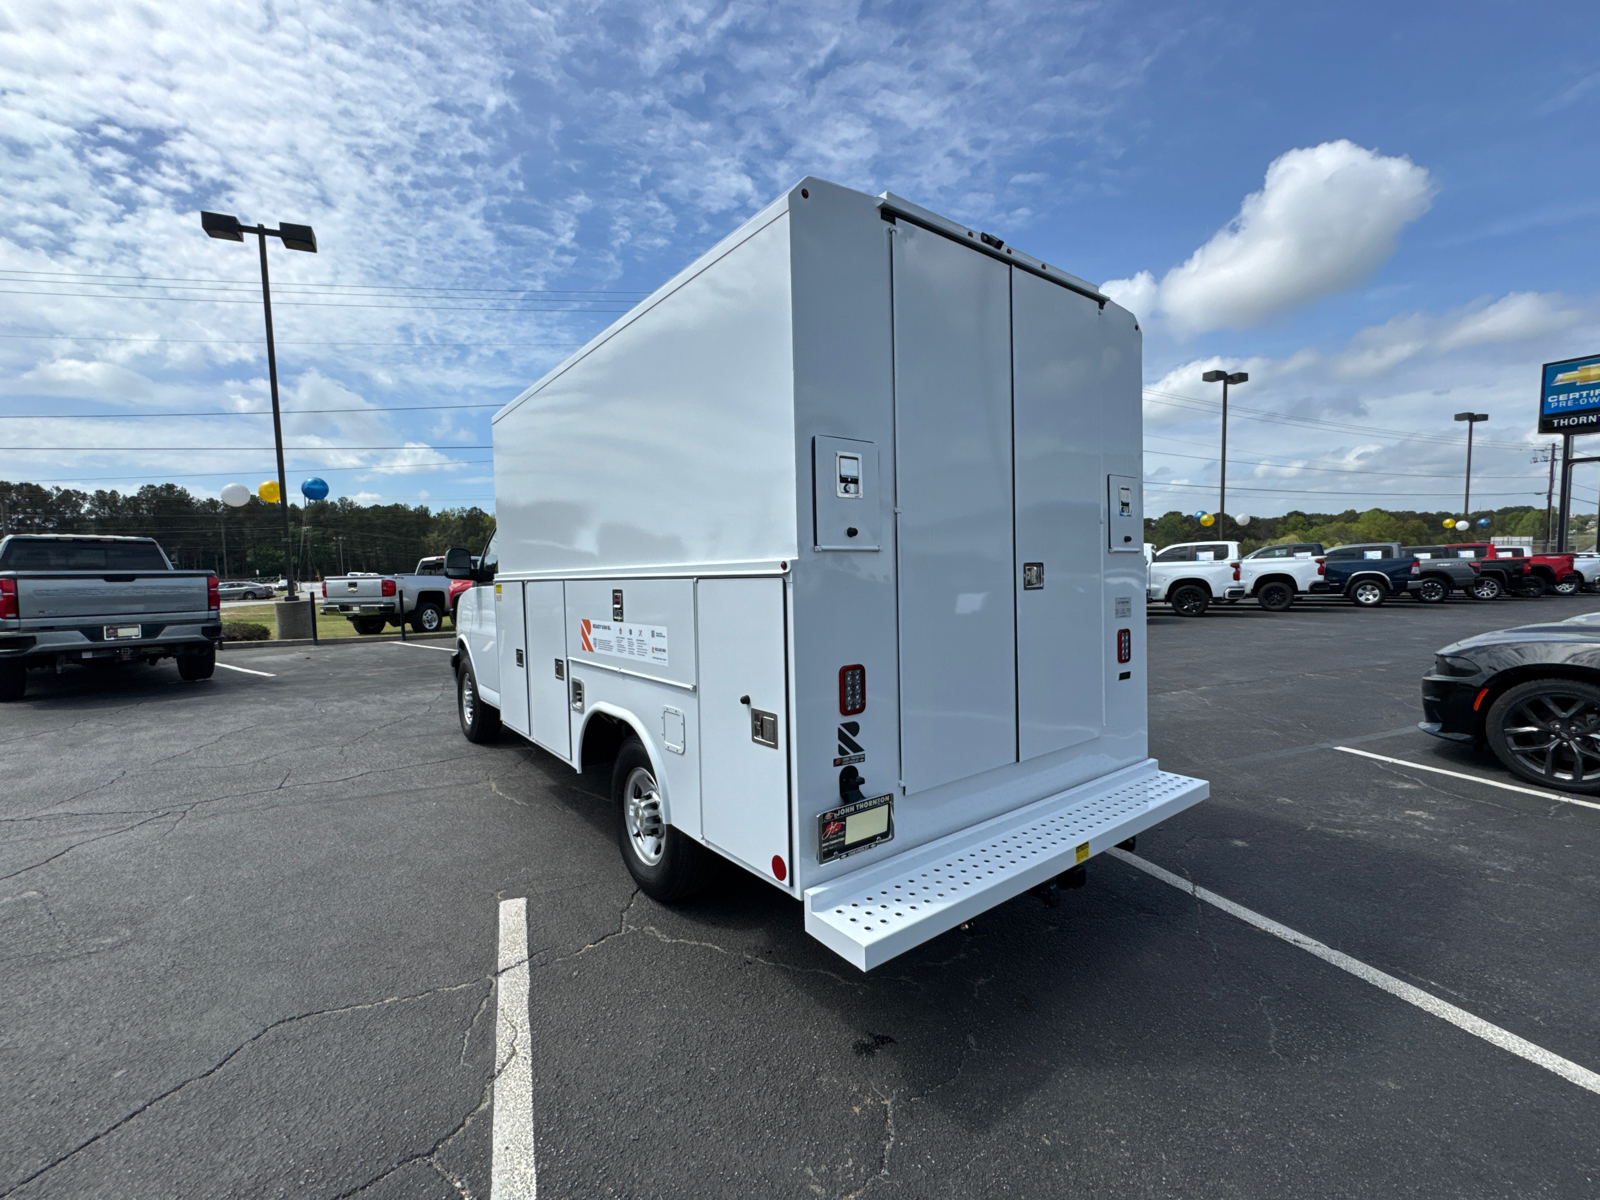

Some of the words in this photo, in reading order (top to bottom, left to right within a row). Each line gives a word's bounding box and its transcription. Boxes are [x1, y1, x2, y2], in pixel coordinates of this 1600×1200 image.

[1552, 414, 1600, 427] THORN
[836, 805, 855, 817] JOHN
[855, 795, 890, 811] THORNTON
